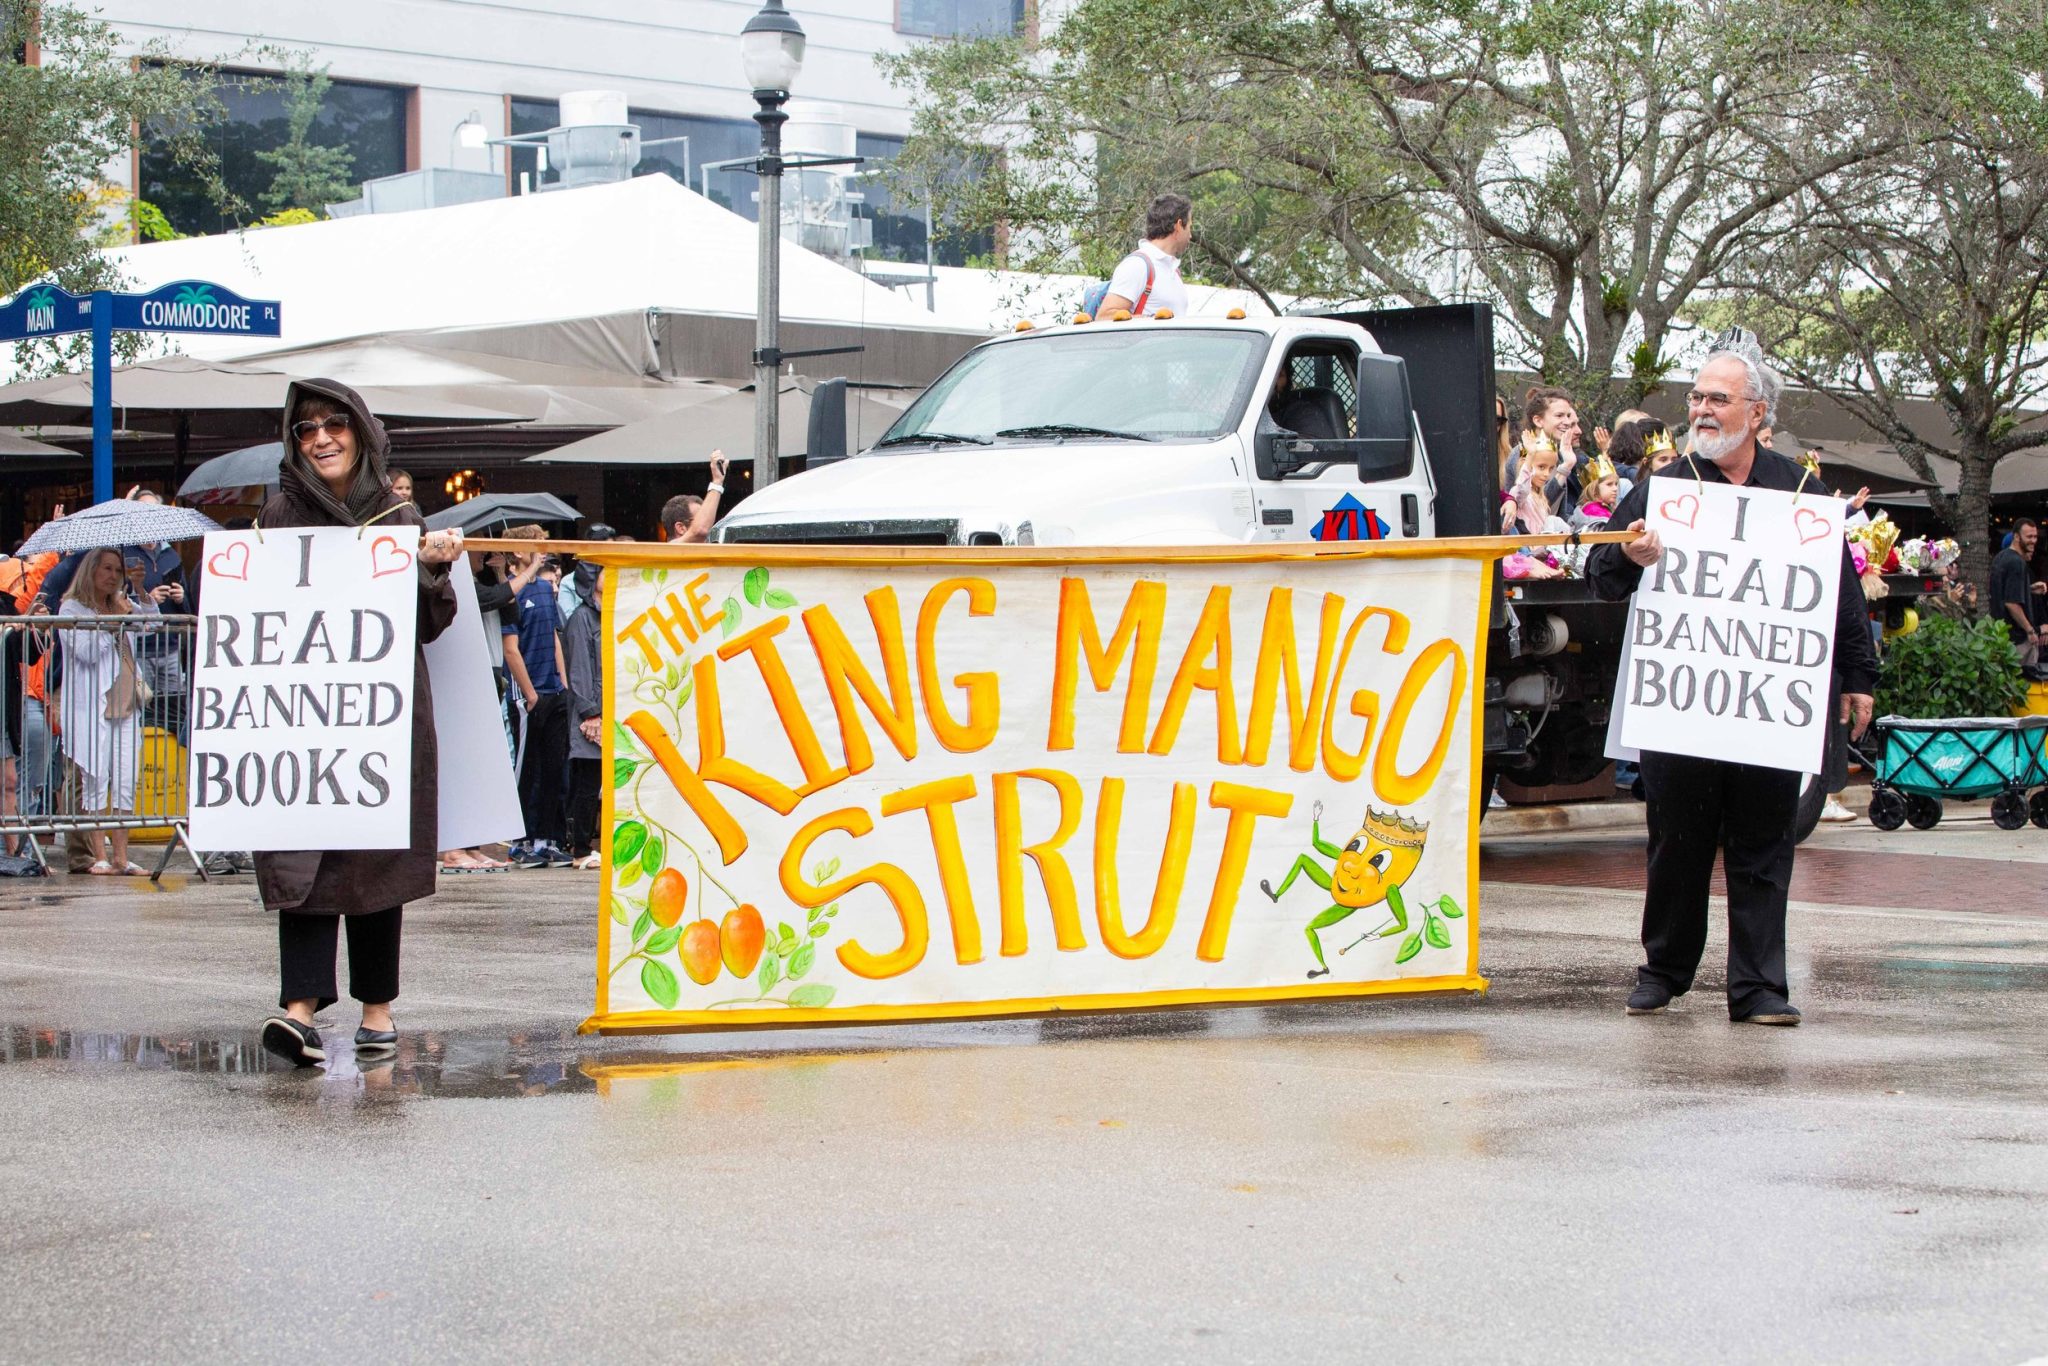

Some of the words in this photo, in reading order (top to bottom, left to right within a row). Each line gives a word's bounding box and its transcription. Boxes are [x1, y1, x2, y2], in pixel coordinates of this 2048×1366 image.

[27, 305, 54, 333] MAIN
[79, 300, 92, 314] HWY
[142, 301, 251, 330] COMMODORE
[264, 307, 276, 320] PL
[1730, 496, 1751, 542] I
[295, 534, 315, 587] I
[1651, 547, 1823, 613] READ
[203, 609, 394, 668] READ
[617, 572, 726, 673] THE
[1633, 608, 1828, 668] BANNED
[193, 681, 404, 731] BANNED
[623, 577, 999, 867] KING
[1047, 577, 1467, 806] MANGO
[1630, 658, 1813, 727] BOOKS
[194, 748, 391, 808] BOOKS
[779, 769, 1294, 981] STRUT
